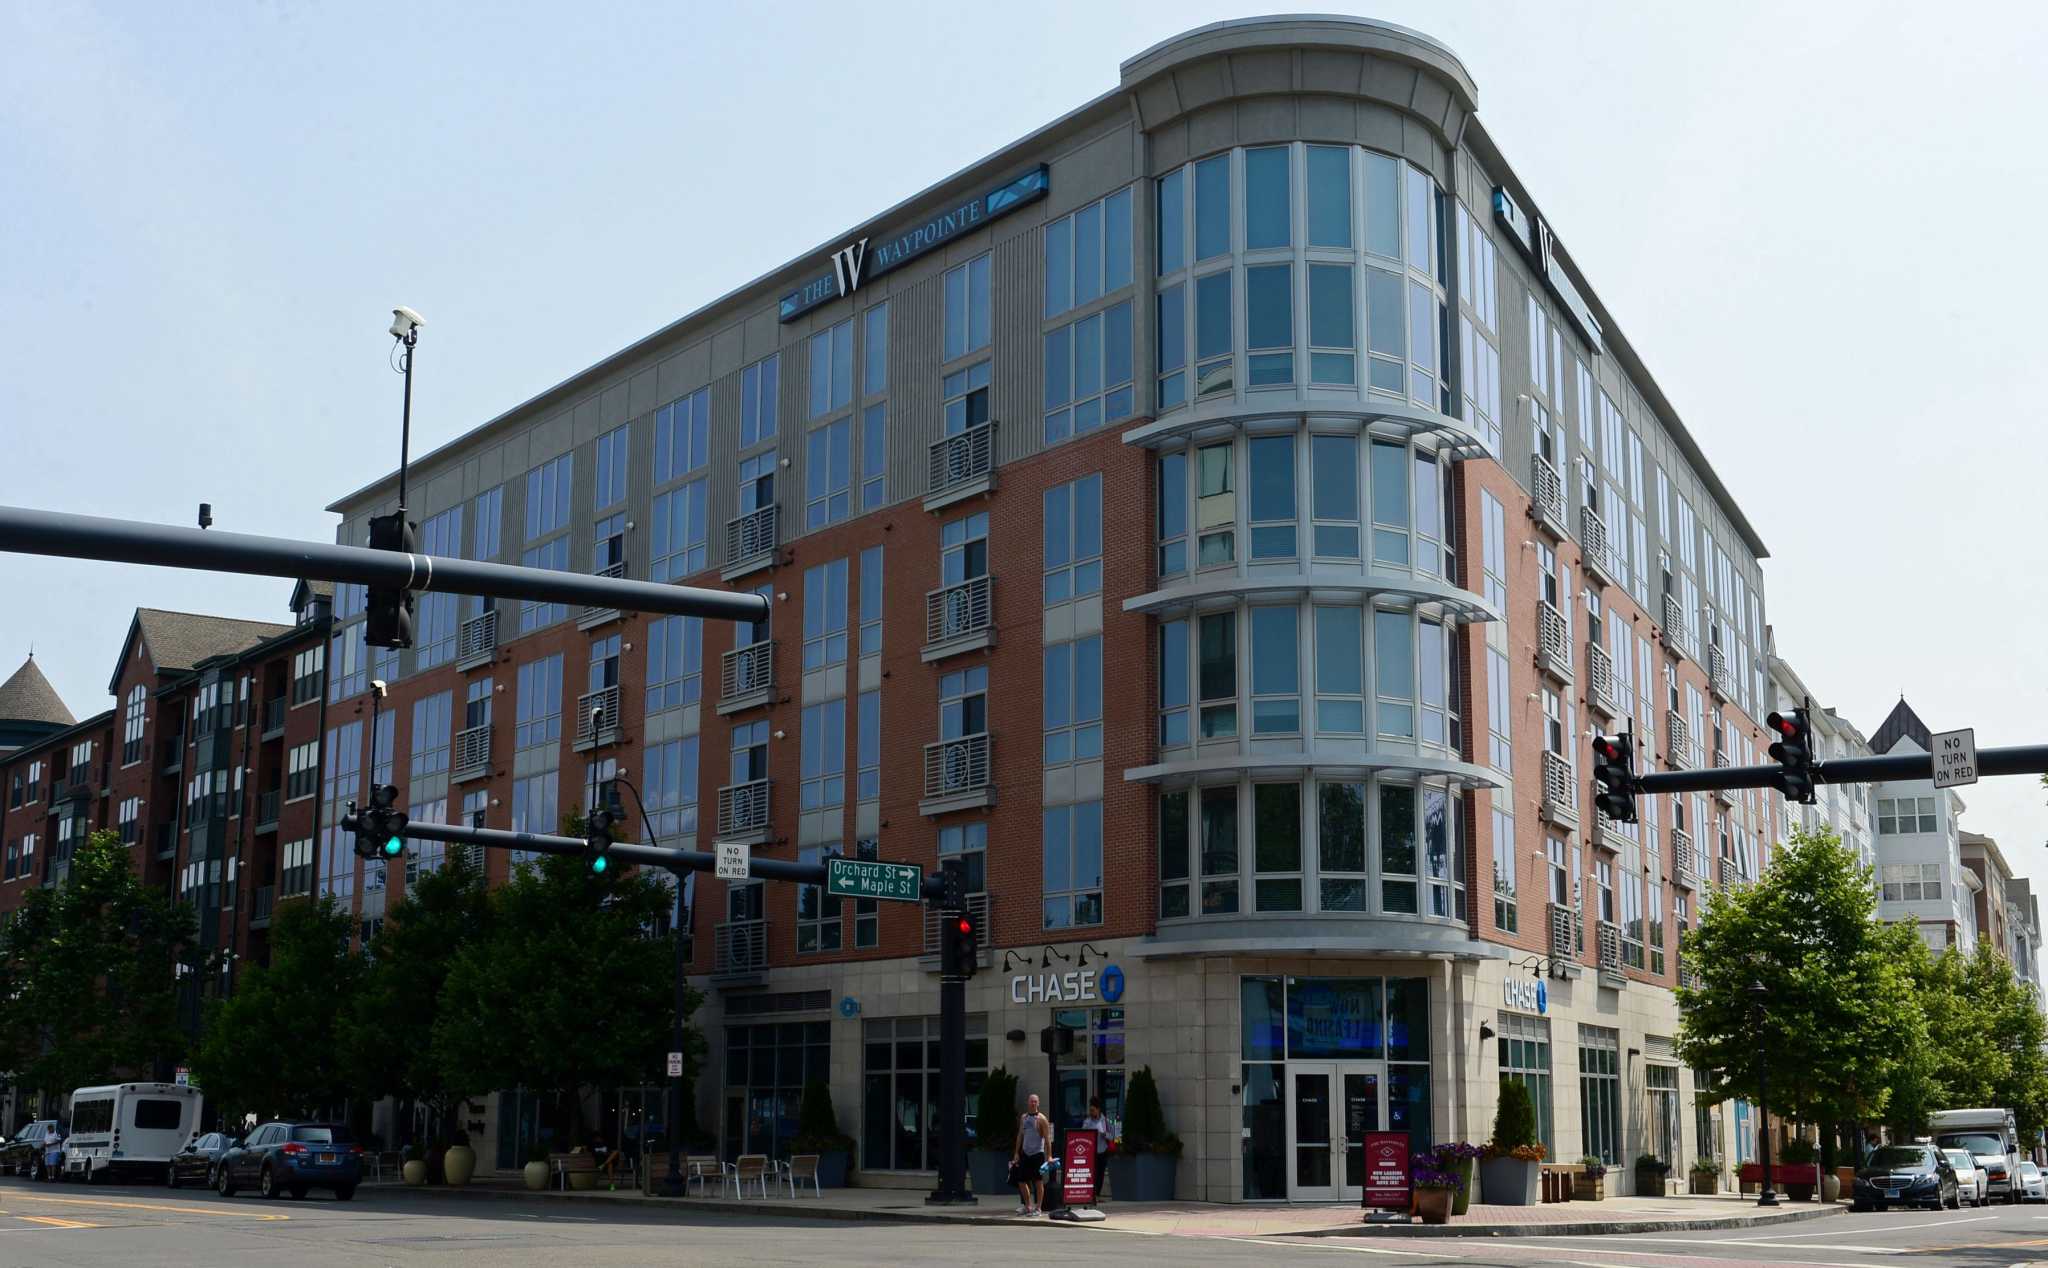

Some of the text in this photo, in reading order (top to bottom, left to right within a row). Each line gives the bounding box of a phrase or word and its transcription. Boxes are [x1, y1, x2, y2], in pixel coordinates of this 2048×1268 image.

[803, 200, 981, 304] THE W WAYPOINTE
[1944, 738, 1960, 750] NO
[1941, 752, 1966, 765] TURN
[1937, 766, 1973, 781] ON RED
[726, 847, 739, 855] NO
[723, 857, 743, 865] TURN
[718, 866, 746, 876] ON RED
[834, 861, 896, 880] Orchard St
[861, 878, 911, 895] Maple St
[1011, 970, 1096, 1003] CHASE
[1503, 976, 1537, 1009] CHASE
